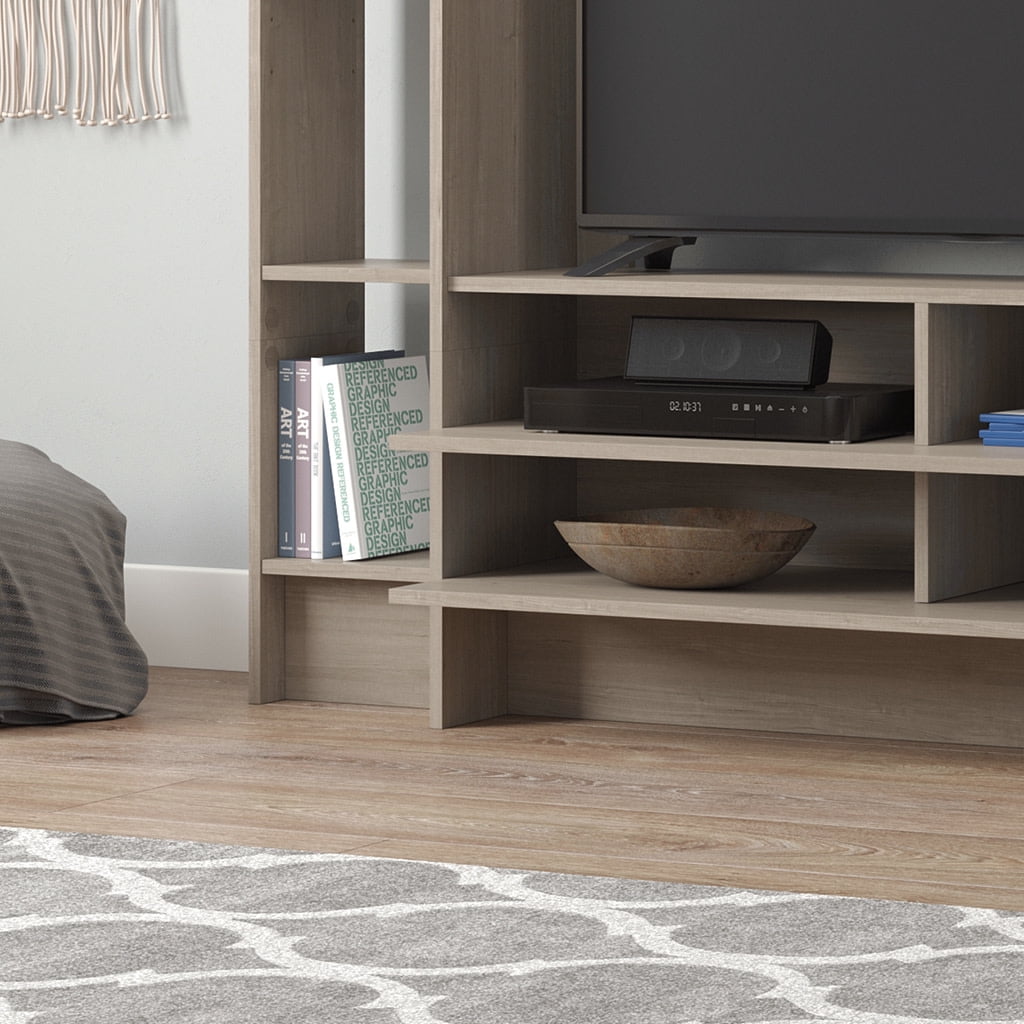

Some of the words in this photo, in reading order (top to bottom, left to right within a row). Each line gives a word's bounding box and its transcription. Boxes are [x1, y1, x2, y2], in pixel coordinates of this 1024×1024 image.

[345, 365, 418, 386] REFERENCED
[327, 382, 338, 423] GRAPHIC
[347, 382, 397, 401] GRAPHIC
[349, 398, 390, 417] DESIGN
[280, 407, 292, 438] ART
[297, 408, 309, 439] ART
[351, 409, 423, 432] REFERENCED
[332, 426, 342, 460] DESIGN
[356, 453, 429, 476] REFERENCED
[358, 471, 408, 491] GRAPHIC
[337, 462, 350, 523] REFERENCED
[360, 487, 401, 507] DESIGN
[364, 515, 413, 536] GRAPHIC
[366, 531, 407, 551] DESIGN
